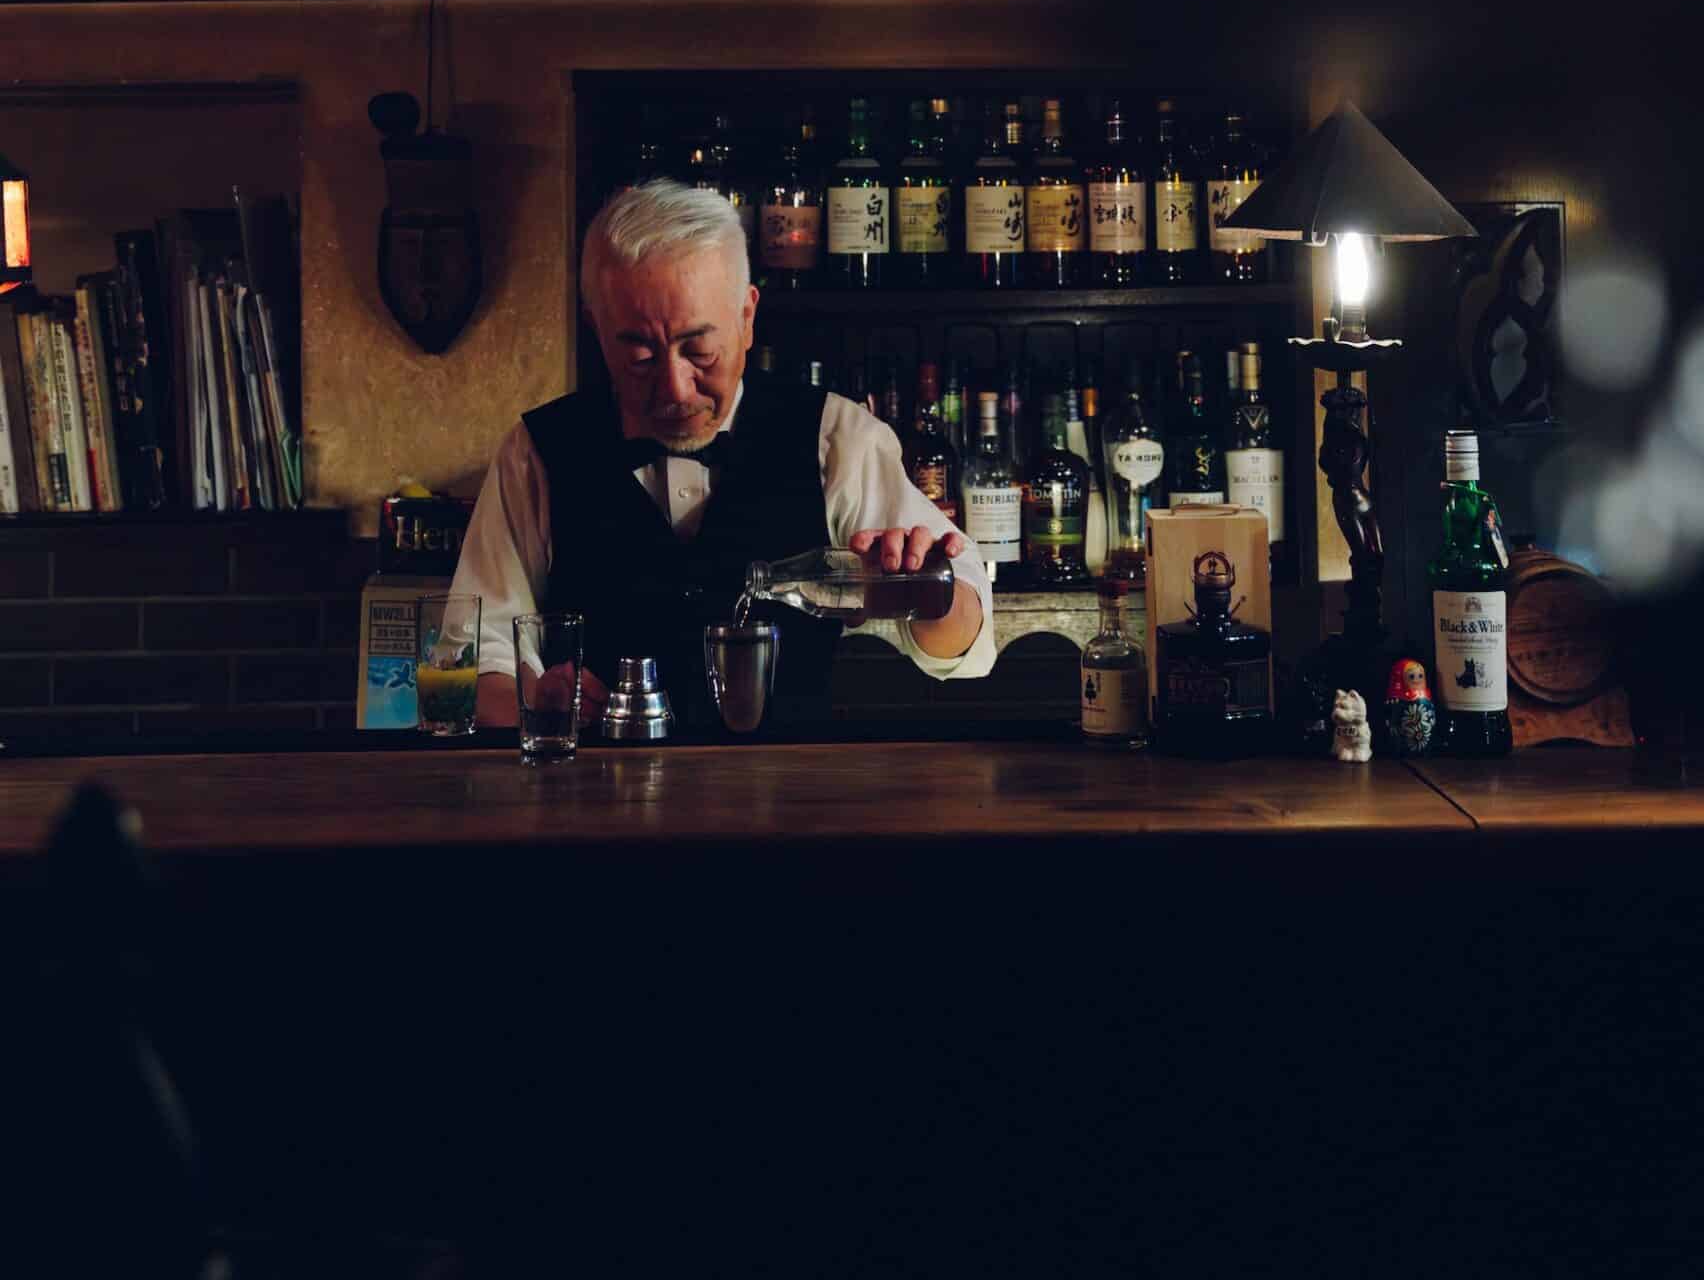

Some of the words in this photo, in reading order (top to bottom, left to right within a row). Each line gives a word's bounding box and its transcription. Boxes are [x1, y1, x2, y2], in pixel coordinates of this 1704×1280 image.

[866, 193, 884, 244] 白州
[1005, 192, 1024, 241] 山崎
[1061, 193, 1082, 237] 山崎
[972, 495, 1019, 505] BENRIAC
[1029, 488, 1081, 500] TOMTIN
